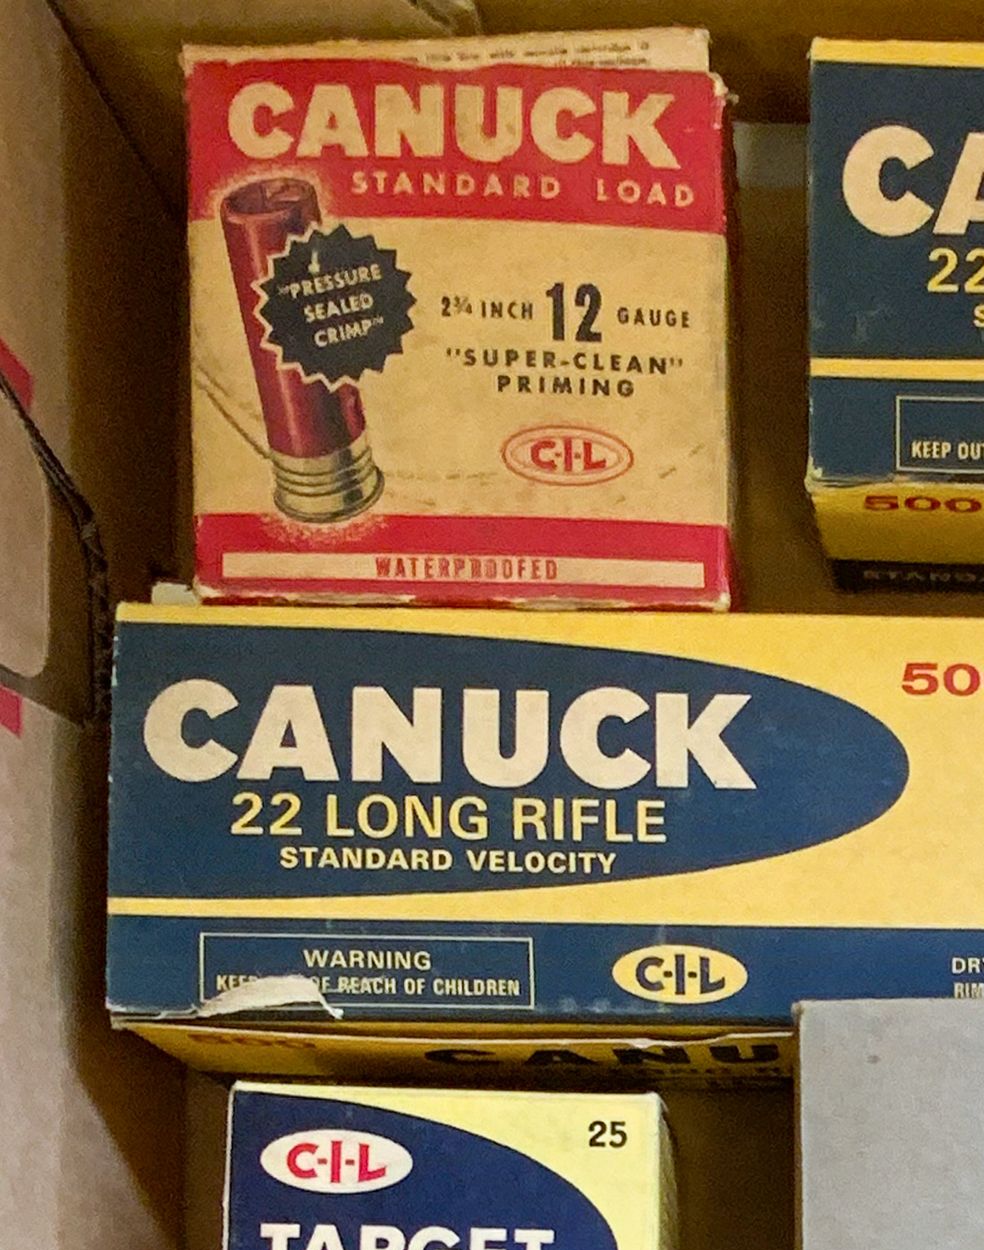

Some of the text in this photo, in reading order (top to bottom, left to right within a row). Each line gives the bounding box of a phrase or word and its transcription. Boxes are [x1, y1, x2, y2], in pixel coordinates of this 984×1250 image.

[228, 81, 681, 170] CANUCK
[351, 169, 696, 208] STANDARD LOAD
[303, 293, 374, 323] SEALED
[481, 300, 534, 320] INCH
[546, 282, 603, 343] 12
[617, 306, 690, 328] GAUGE
[497, 375, 635, 398] PRIMING
[911, 440, 951, 459] KEEP
[863, 495, 983, 514] 500
[374, 556, 559, 581] WATERPROOFED
[142, 678, 757, 789] CANUCK
[230, 792, 667, 843] 22 LONG RIFLE
[279, 846, 617, 875] STANDARD VELOCITY
[303, 949, 432, 971] WARNING
[216, 974, 257, 991] KEE
[338, 976, 396, 995] REACH
[404, 977, 427, 995] OF
[433, 977, 521, 997] CHILDREN
[953, 982, 984, 999] RIM
[424, 1044, 782, 1066] CANU
[588, 1120, 628, 1149] 25
[286, 1140, 387, 1184] C-I-L
